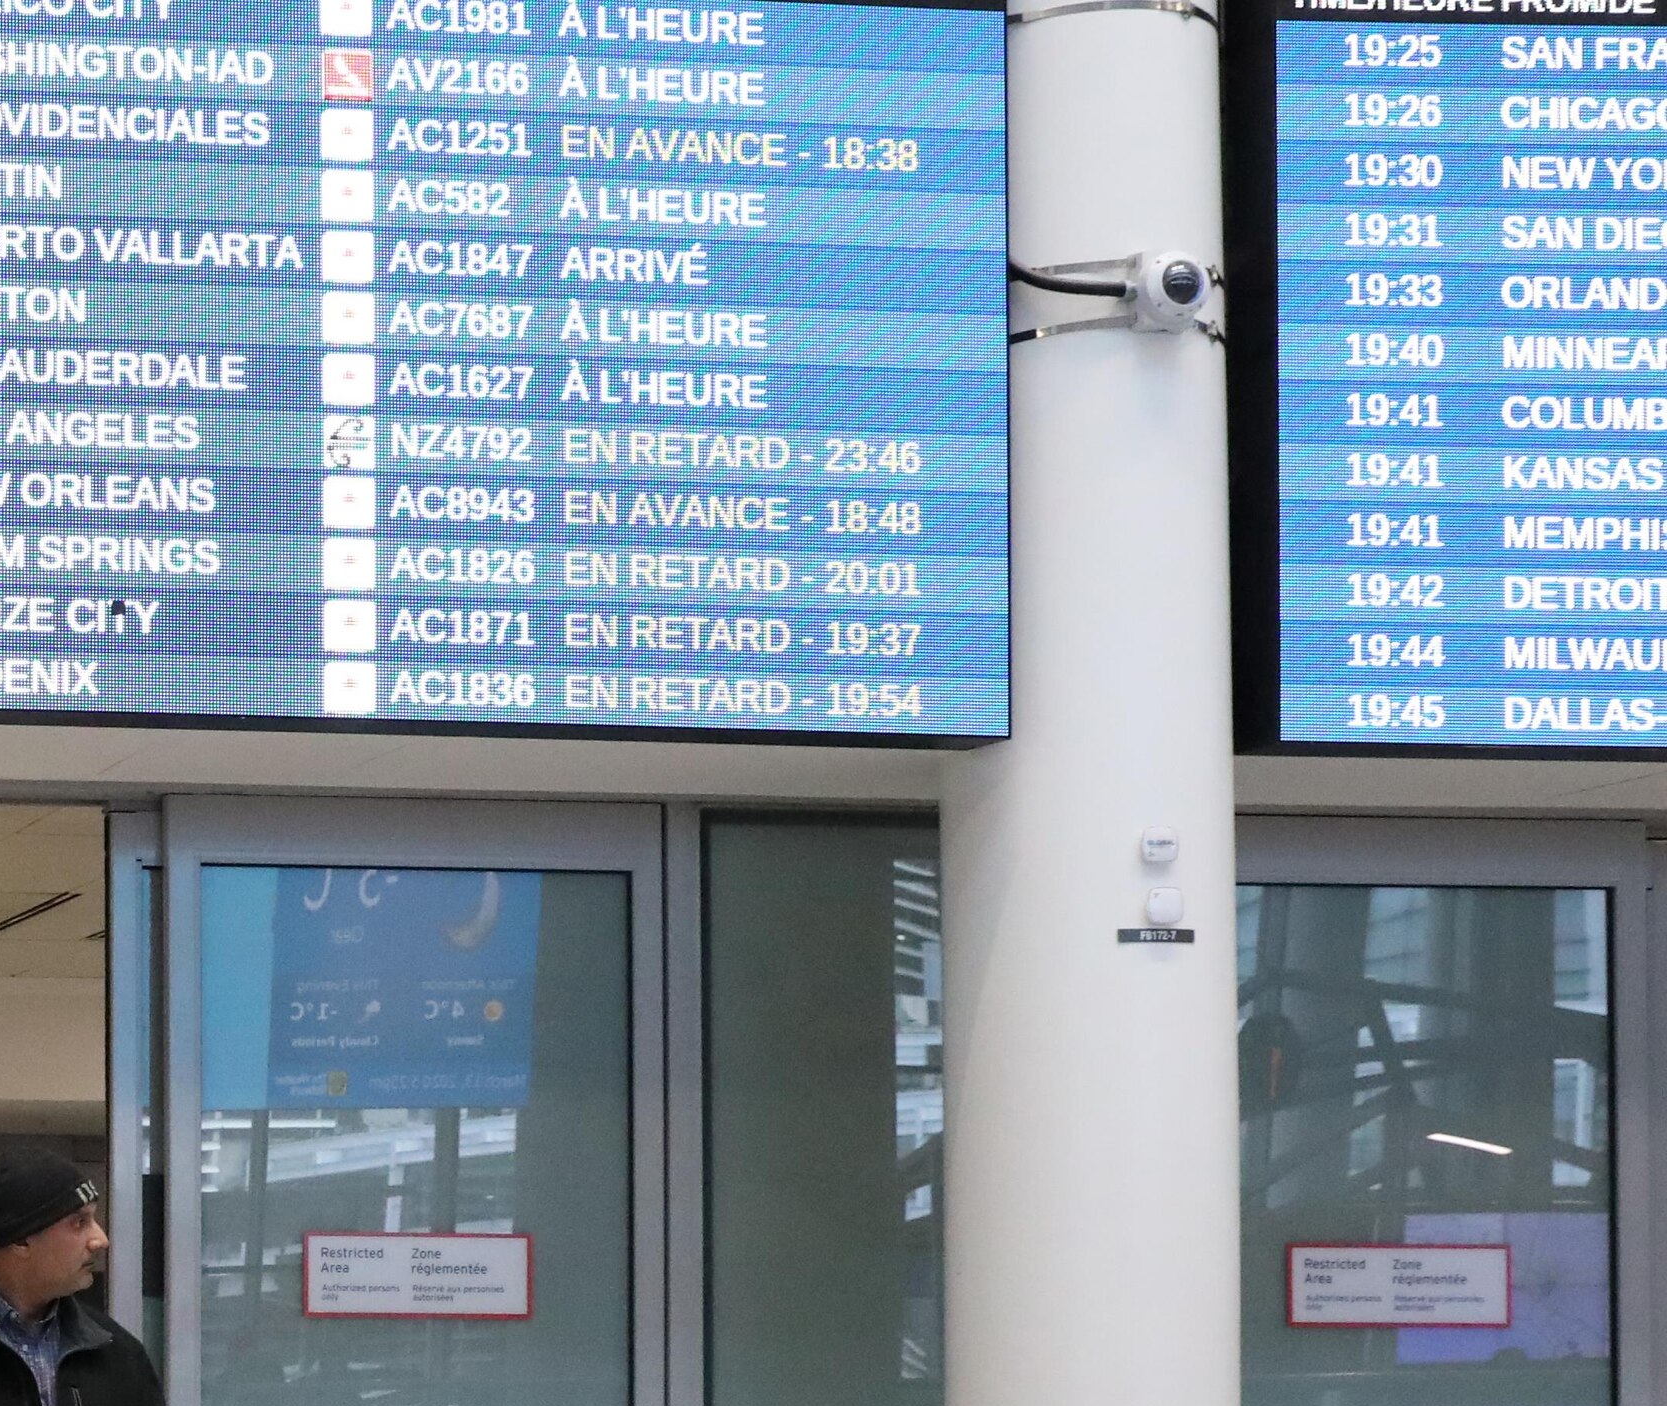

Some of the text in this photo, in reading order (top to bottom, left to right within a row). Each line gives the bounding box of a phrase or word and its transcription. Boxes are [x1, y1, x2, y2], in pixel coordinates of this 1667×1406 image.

[1344, 32, 1443, 69] 19:25
[1501, 35, 1584, 70] SAN
[386, 57, 530, 97] AV2166
[557, 55, 588, 98] À
[596, 65, 766, 108] L'HEURE
[387, 177, 511, 218] AC582
[558, 176, 589, 220] À
[597, 186, 767, 228] L'HEURE
[1345, 272, 1444, 308] 19:33
[5, 409, 201, 451] ANGELES
[390, 421, 532, 463] NZ4792
[562, 427, 619, 465] EN
[629, 428, 791, 471] RETARD
[824, 436, 923, 475] 23:46
[1346, 452, 1664, 492] 19:41 KANSAS
[37, 534, 221, 576] SPRINGS
[389, 545, 536, 585] AC1826
[562, 548, 618, 587] EN
[629, 551, 791, 592] RETARD
[823, 558, 922, 598] 20:01
[1347, 572, 1445, 608] 19:42
[389, 670, 536, 709] AC1836
[564, 673, 619, 711] EN
[629, 676, 793, 718] RETARD
[825, 681, 924, 719] 19:54
[1347, 693, 1446, 729] 19:45
[320, 1247, 384, 1259] Restricted
[320, 1263, 350, 1274] Area
[411, 1248, 442, 1260] Zone
[411, 1263, 488, 1276] réglementée
[1304, 1258, 1366, 1270] Restricted
[1392, 1259, 1423, 1271] Zone
[1304, 1273, 1333, 1285] Area
[1392, 1275, 1467, 1288] réglementée
